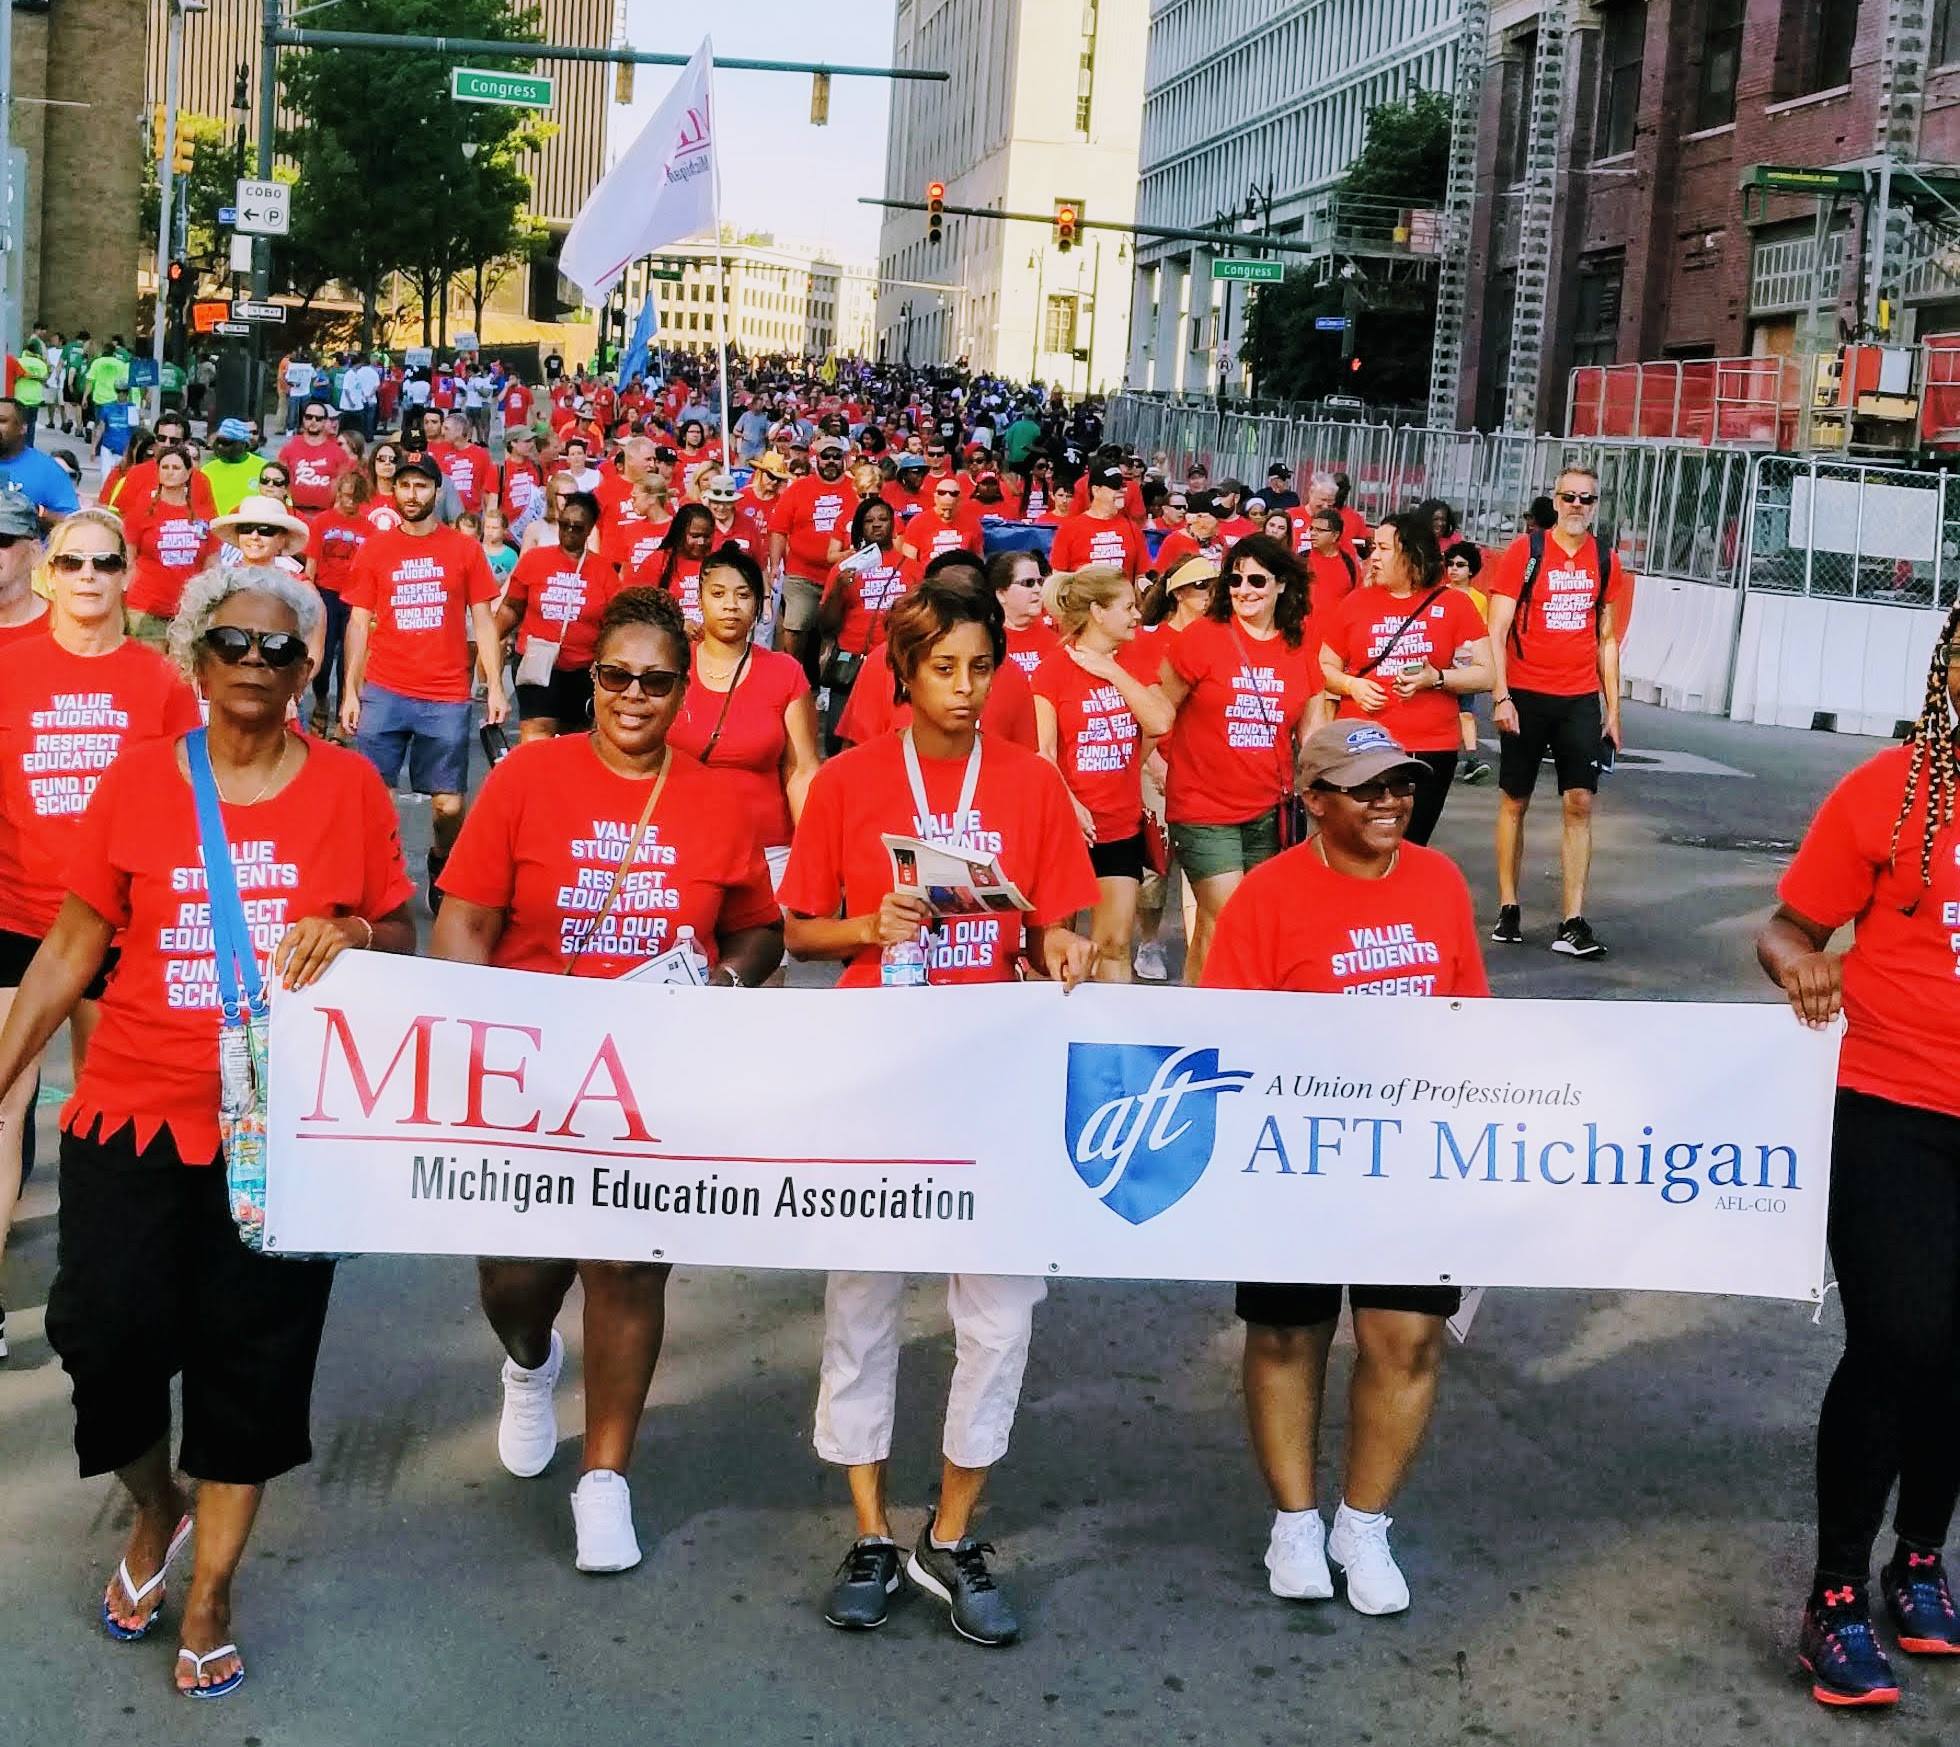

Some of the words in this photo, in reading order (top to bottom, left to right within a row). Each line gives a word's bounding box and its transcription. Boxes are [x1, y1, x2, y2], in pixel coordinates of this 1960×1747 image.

[470, 79, 537, 98] Congress
[246, 187, 282, 199] COBO
[1224, 264, 1272, 278] Congress
[402, 557, 433, 569] VALUE
[392, 567, 445, 581] STUDENTS
[391, 591, 448, 606] EDUCATORS
[397, 581, 442, 596] RESPECT
[53, 693, 113, 709] VALUE
[31, 711, 128, 728] STUDENTS
[36, 734, 121, 752] RESPECT
[31, 776, 79, 797] FUND
[179, 898, 288, 926] REECT
[623, 916, 668, 938] OUR
[956, 920, 999, 943] OUR
[1349, 923, 1416, 950] VALUE
[1331, 942, 1440, 977] STUDENTS
[165, 959, 219, 983] FUN
[300, 1006, 662, 1143] MEA
[1266, 1075, 1284, 1096] A
[1293, 1075, 1373, 1099] Union
[1380, 1077, 1411, 1107] of
[1411, 1079, 1583, 1109] Professionals
[1075, 1045, 1254, 1199] aft
[1241, 1114, 1403, 1179] AFT
[1428, 1120, 1804, 1204] Michigan
[411, 1155, 575, 1213] Michigan
[592, 1167, 760, 1216] Education
[774, 1176, 975, 1221] Association
[1714, 1196, 1787, 1214] AFL-CIO
